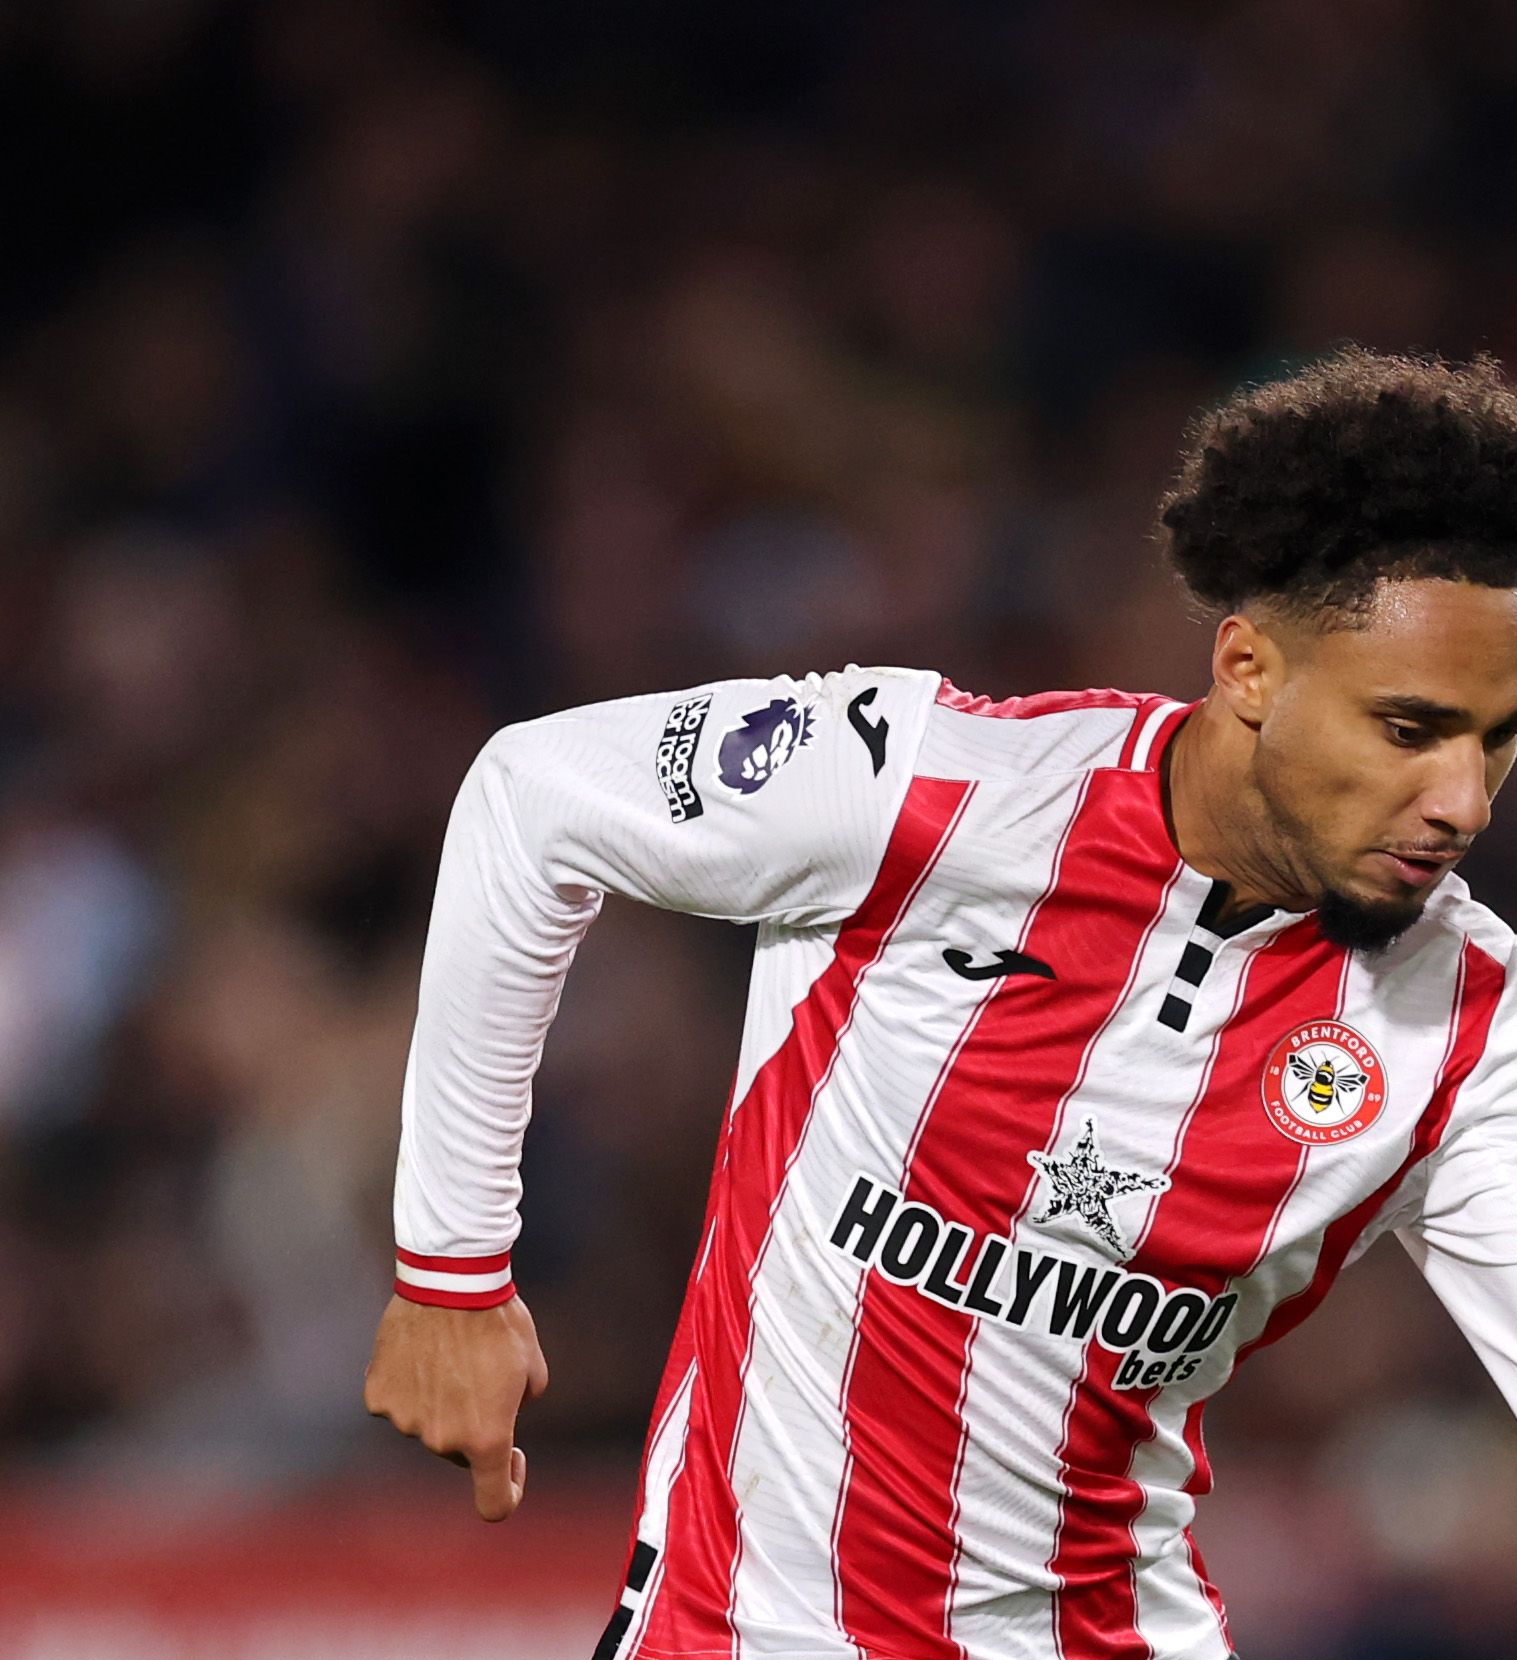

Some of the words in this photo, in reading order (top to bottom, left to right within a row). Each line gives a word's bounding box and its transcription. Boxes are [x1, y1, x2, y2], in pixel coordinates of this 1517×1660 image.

[666, 700, 694, 732] for
[684, 693, 712, 730] No
[657, 735, 686, 822] racism
[672, 733, 697, 805] room
[1291, 1026, 1375, 1068] BRENTFORD
[1271, 1100, 1327, 1140] FOOTBALL
[1330, 1119, 1364, 1139] CLUB
[829, 1176, 1239, 1354] HOLLYWOOD
[1116, 1350, 1202, 1386] bets
